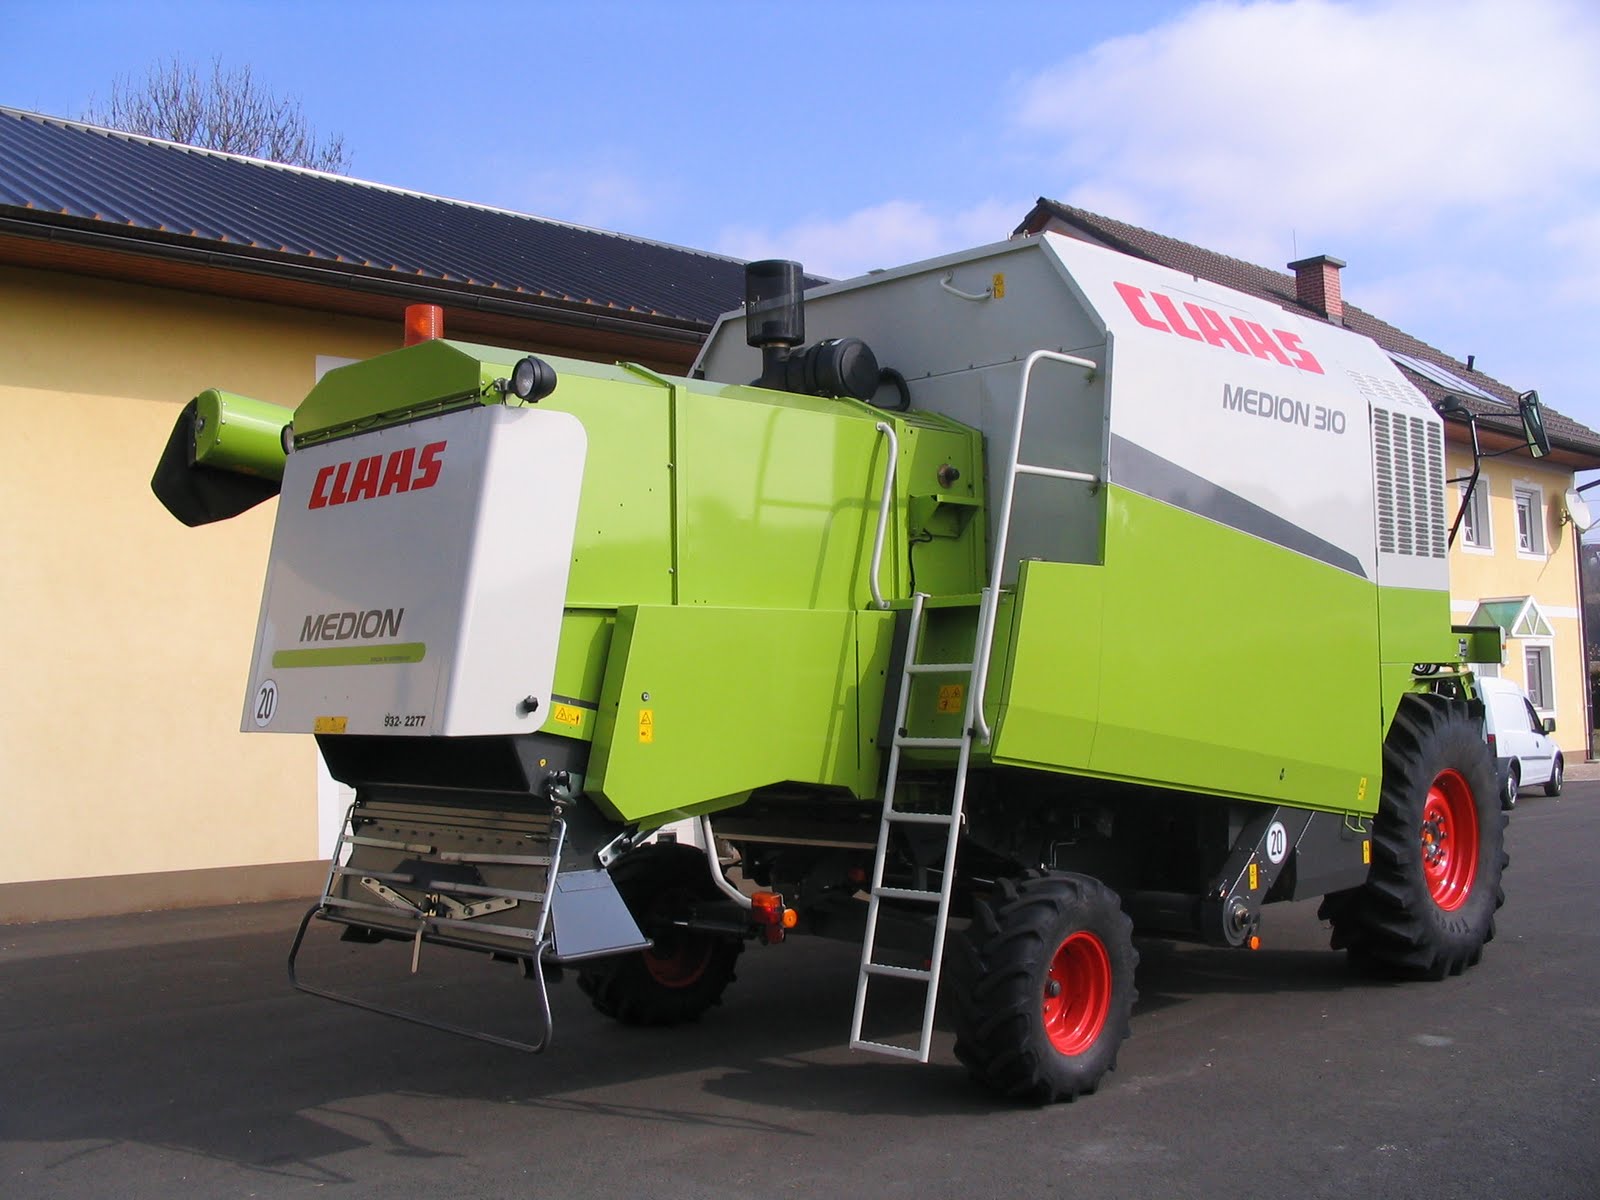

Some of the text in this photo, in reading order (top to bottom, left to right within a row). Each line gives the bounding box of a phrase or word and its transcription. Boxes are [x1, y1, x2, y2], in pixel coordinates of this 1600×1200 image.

[1113, 281, 1325, 375] CLAAS
[1222, 383, 1346, 435] MEDION 310
[308, 440, 447, 510] CLAAS
[299, 607, 405, 642] MEDION
[257, 687, 274, 719] 20
[404, 715, 426, 727] 2277
[1271, 829, 1283, 856] 20
